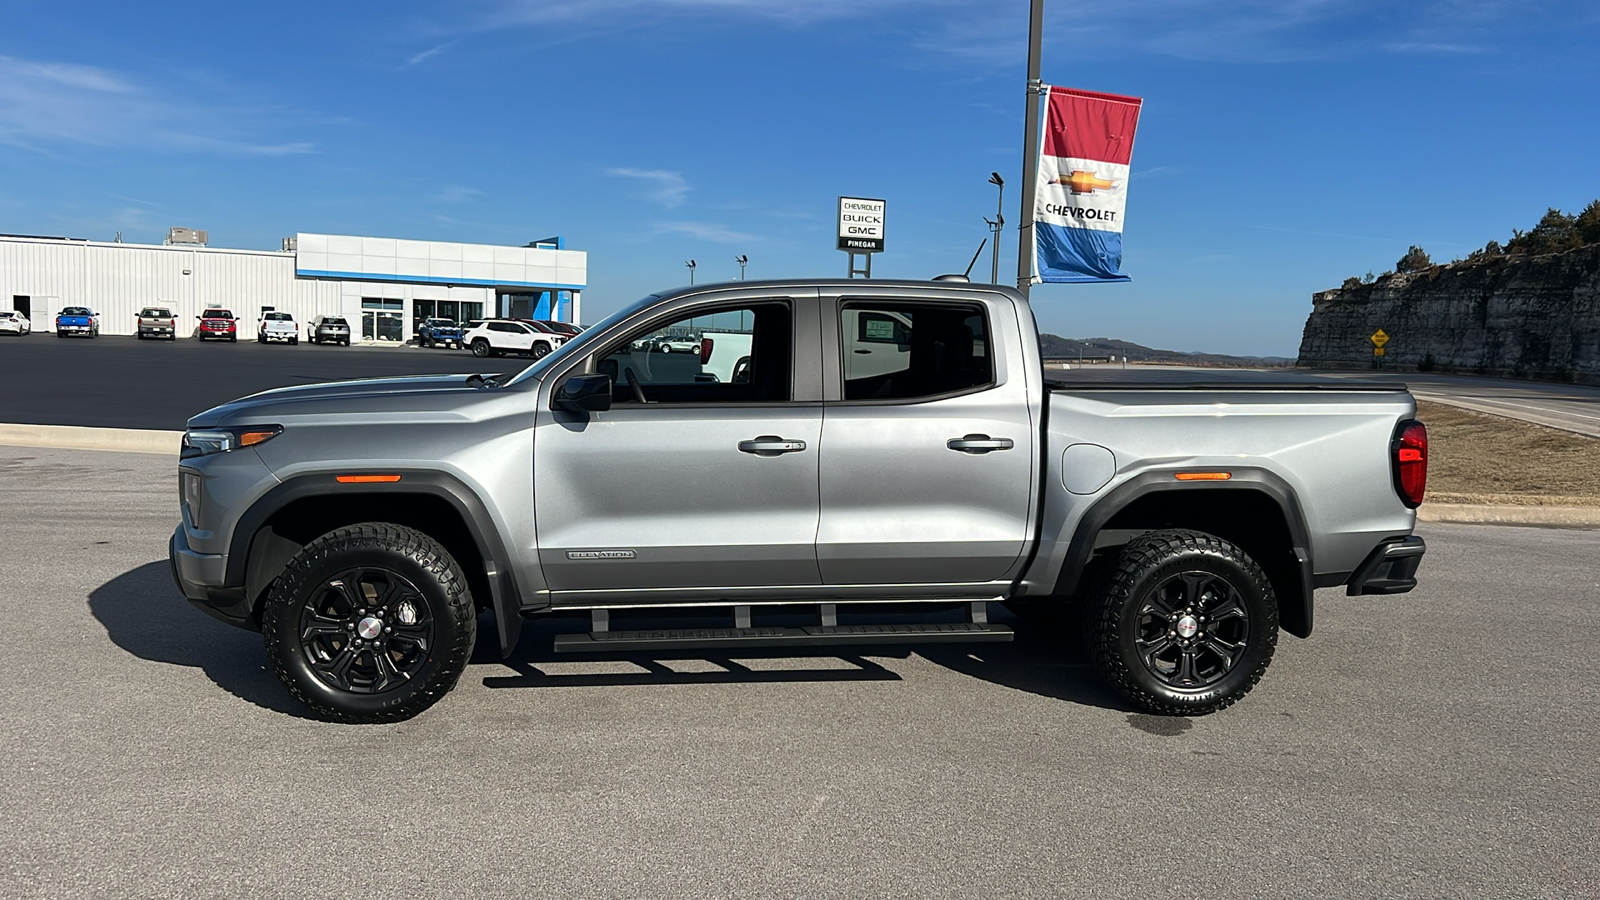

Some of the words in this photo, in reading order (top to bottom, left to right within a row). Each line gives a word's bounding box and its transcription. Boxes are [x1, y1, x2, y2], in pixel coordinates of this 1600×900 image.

[844, 203, 882, 211] CHEVROLET
[1045, 203, 1117, 222] CHEVROLET
[843, 214, 881, 223] BUICK
[848, 226, 876, 235] GMC
[847, 240, 876, 248] PINEGAR
